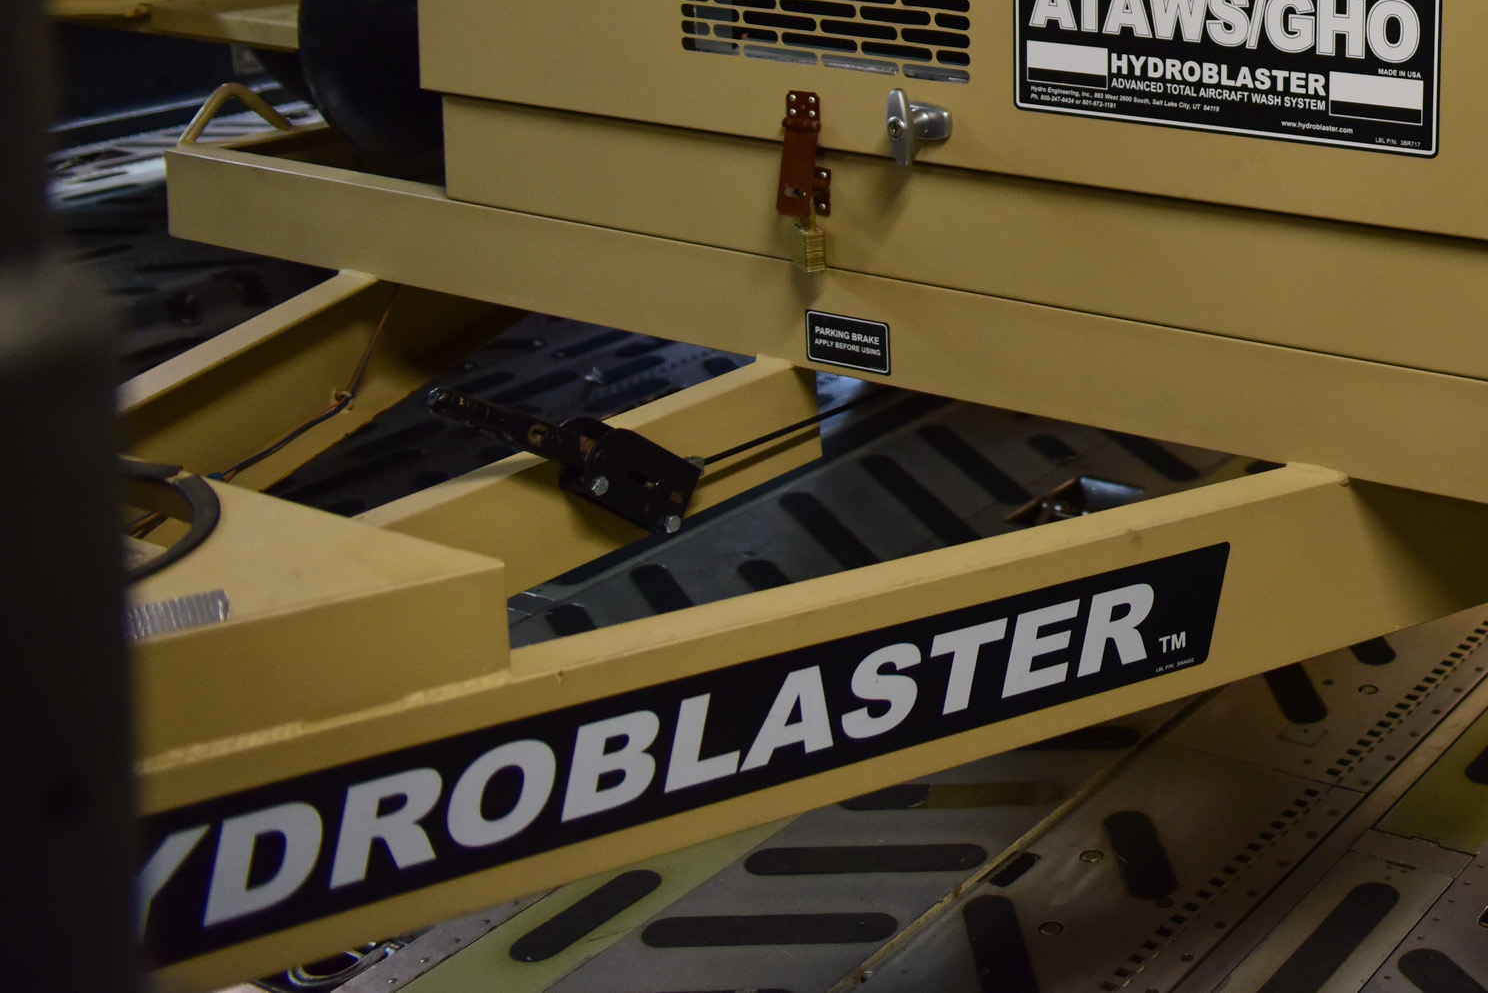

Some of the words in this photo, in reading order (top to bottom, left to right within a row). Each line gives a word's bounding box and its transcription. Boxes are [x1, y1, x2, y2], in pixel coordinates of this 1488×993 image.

[1110, 53, 1326, 96] HYDROBLASTER
[1378, 68, 1398, 76] MADE
[1030, 85, 1046, 94] Hydro
[1048, 86, 1080, 98] Engineering,
[1104, 93, 1119, 101] West
[1133, 96, 1151, 105] South,
[1152, 98, 1163, 106] Salt
[1164, 99, 1178, 108] Lake
[1178, 100, 1191, 110] City,
[1203, 104, 1220, 112] 84119
[1111, 78, 1164, 93] ADVANCED
[1166, 83, 1197, 97] TOTAL
[1199, 87, 1249, 102] AIRCRAFT
[1251, 93, 1282, 107] WASH
[1284, 96, 1326, 111] SYSTEM
[1281, 120, 1354, 134] www.hydroblaster.com
[1386, 137, 1397, 146] P/N:
[815, 326, 850, 340] PARKING
[852, 332, 880, 345] BRAKE
[814, 338, 834, 347] APPLY
[835, 342, 860, 353] BEFORE
[861, 346, 881, 356] USING
[134, 583, 1154, 945] YDROBLASTER
[1159, 631, 1186, 653] TM
